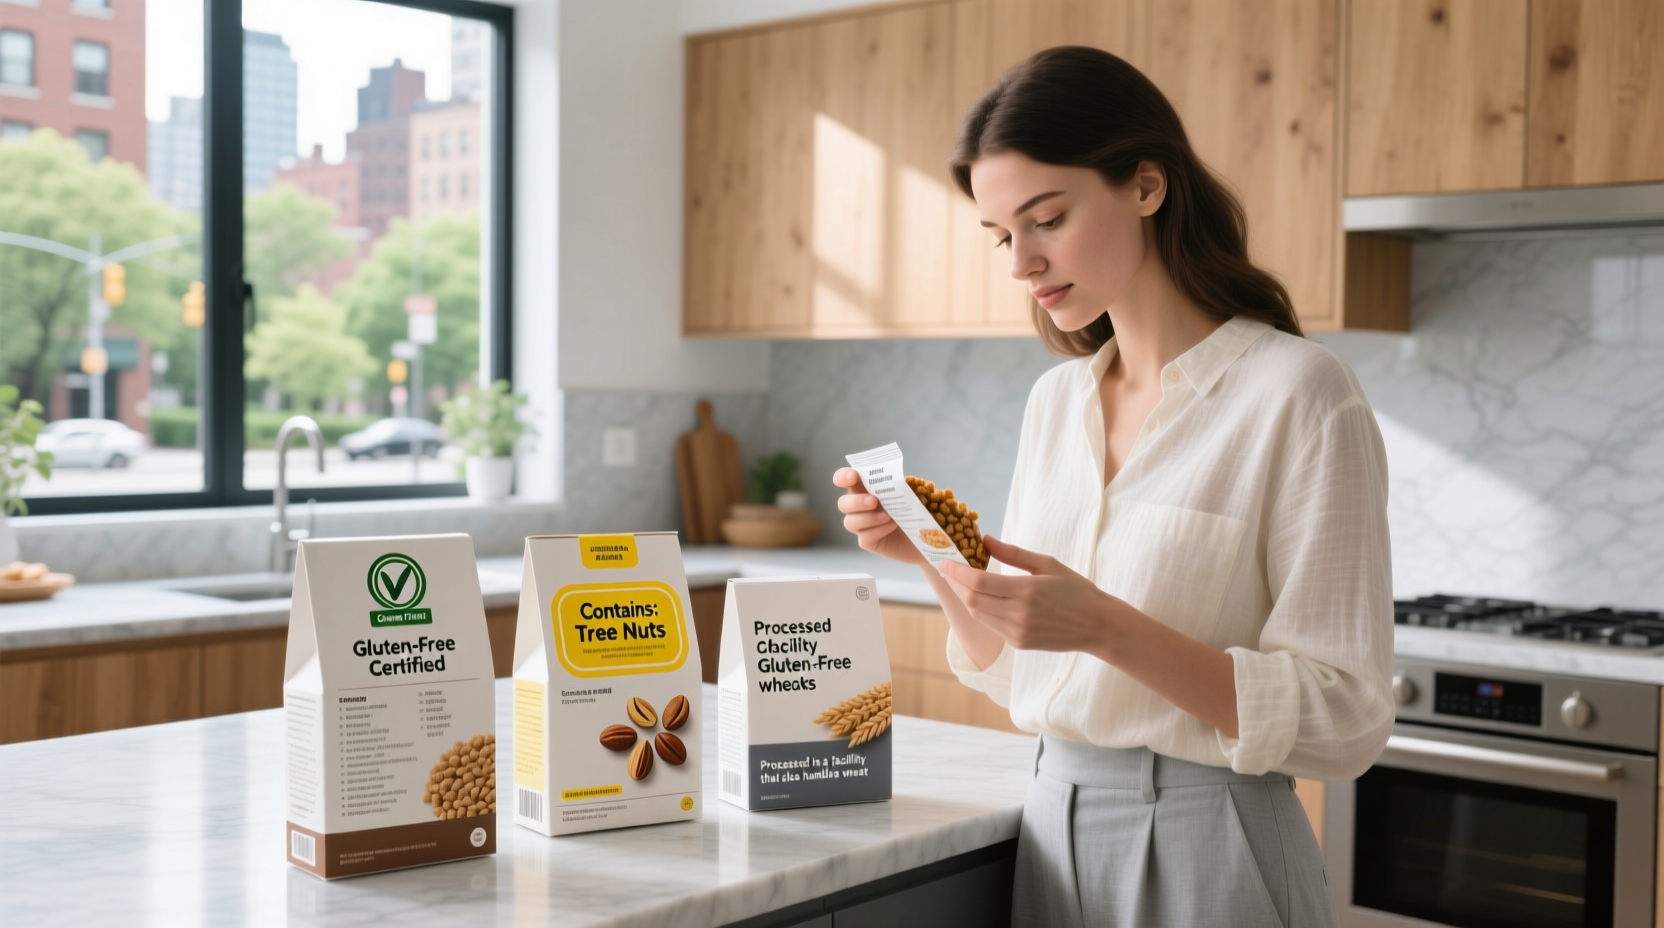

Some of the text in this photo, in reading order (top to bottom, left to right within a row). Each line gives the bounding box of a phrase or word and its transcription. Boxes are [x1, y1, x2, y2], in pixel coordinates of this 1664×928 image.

[580, 601, 658, 620] Contains:
[575, 622, 666, 643] Tree Nuts
[754, 617, 831, 636] Processed
[353, 636, 456, 657] Gluten-Free
[369, 655, 446, 676] Certified
[758, 655, 852, 673] Gluten-Free
